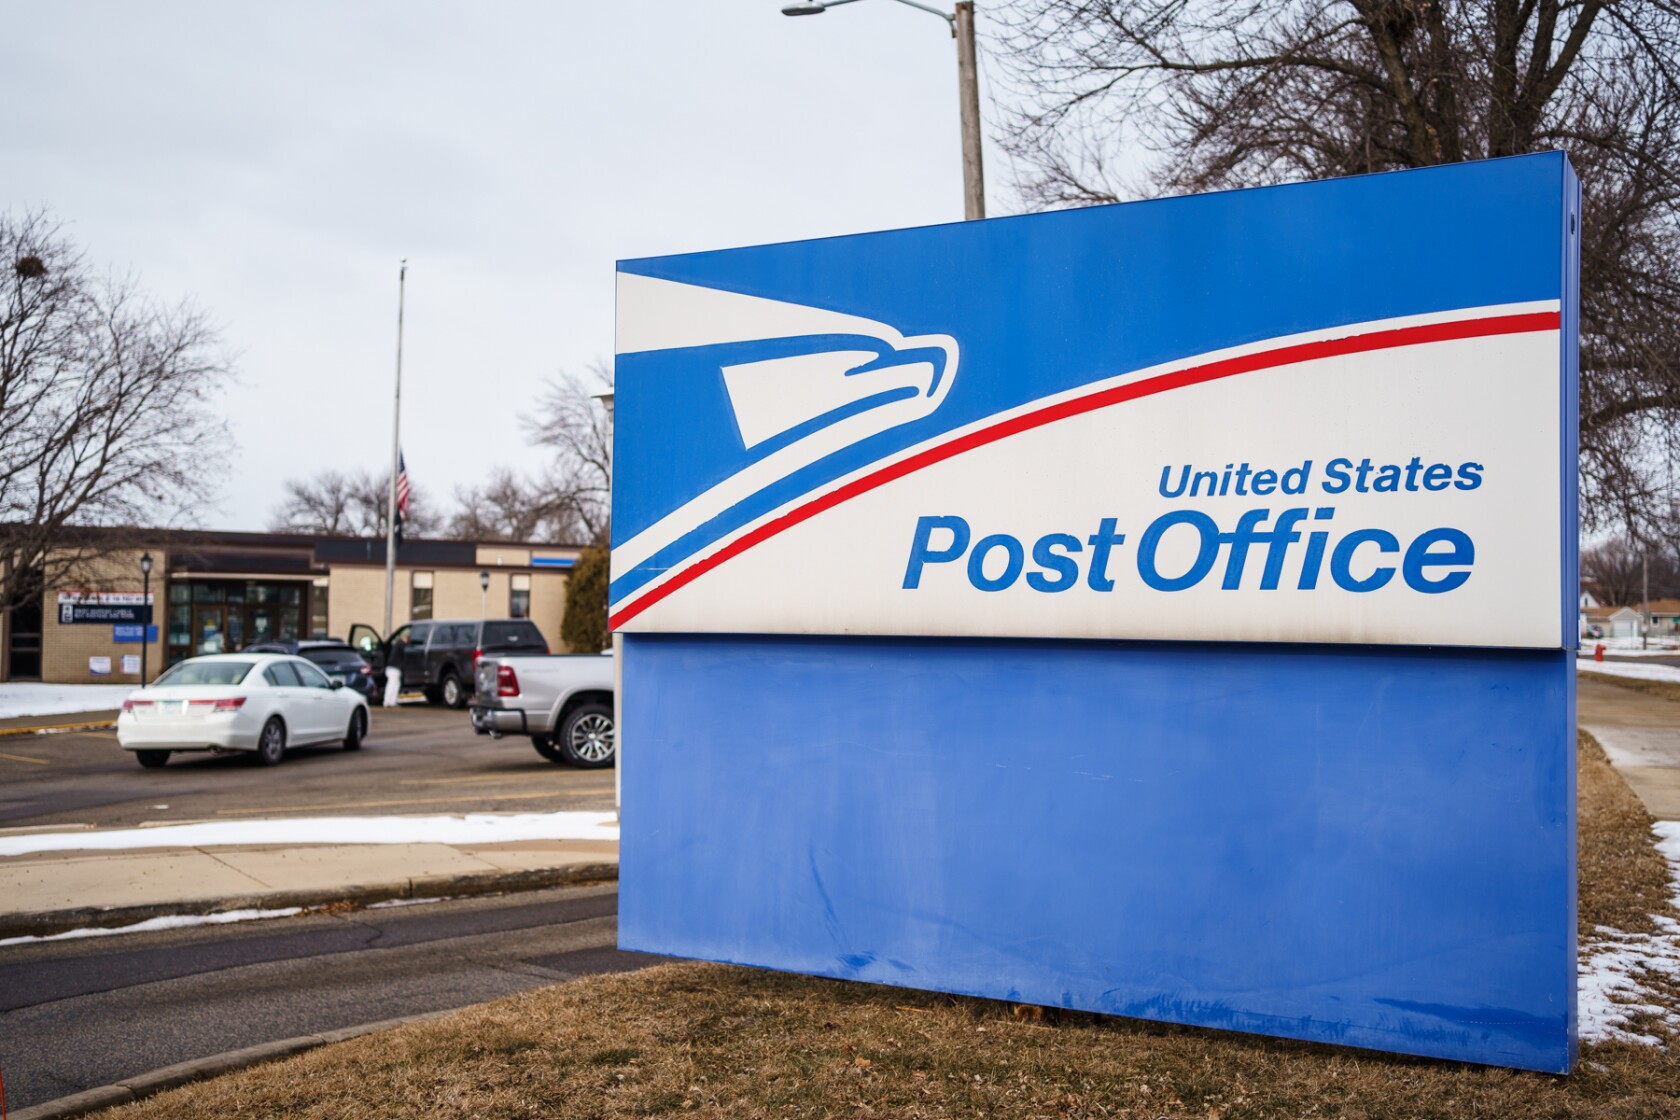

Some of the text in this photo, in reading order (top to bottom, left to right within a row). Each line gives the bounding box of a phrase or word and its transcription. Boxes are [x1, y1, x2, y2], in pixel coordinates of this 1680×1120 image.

[1159, 457, 1484, 498] United States
[902, 507, 1475, 594] Post Office
